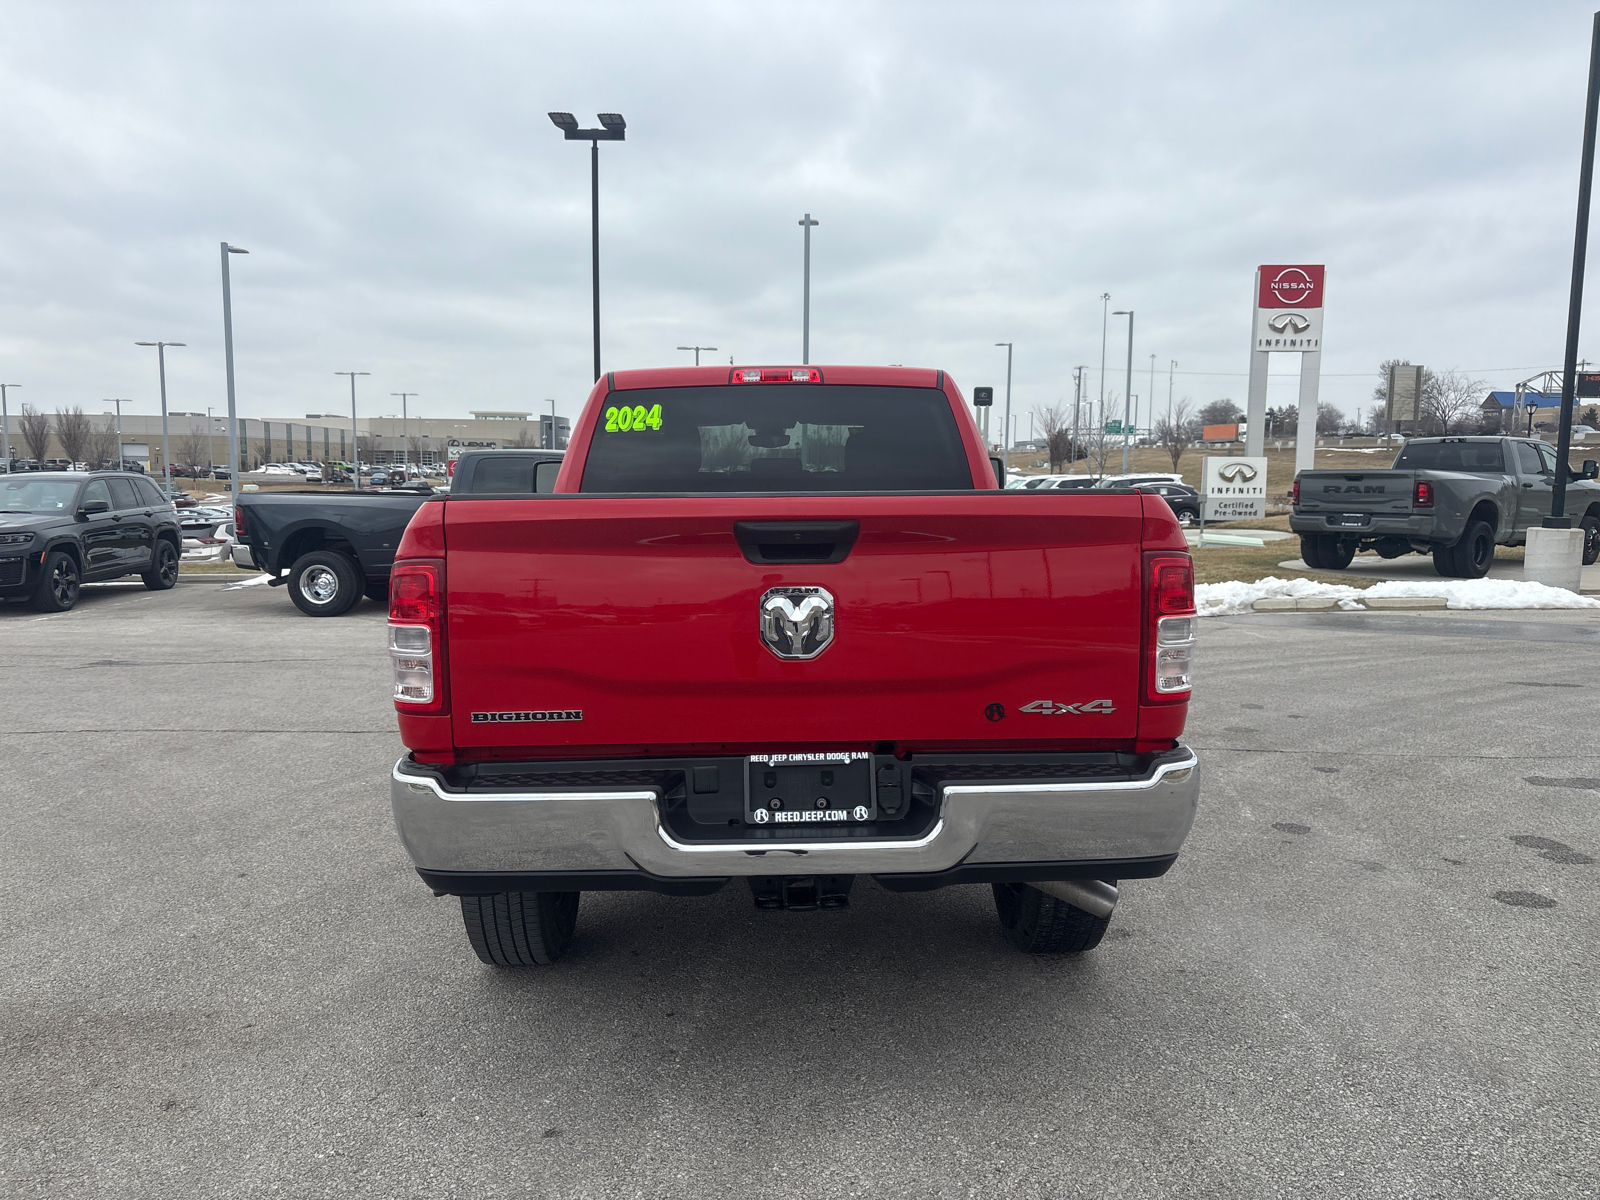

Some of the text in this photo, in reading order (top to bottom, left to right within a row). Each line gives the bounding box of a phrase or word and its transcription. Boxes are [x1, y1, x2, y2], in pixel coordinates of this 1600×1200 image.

[1258, 338, 1319, 347] INFINITI
[605, 404, 663, 432] 2024
[1322, 485, 1386, 494] RAM
[1218, 501, 1254, 509] Certified
[1214, 509, 1258, 517] Pre-Owned
[470, 709, 583, 723] BIGHORN
[750, 751, 869, 763] REED JEEP CHRYSLER DODGE RAM
[775, 810, 847, 822] REEDJEEP.COM
